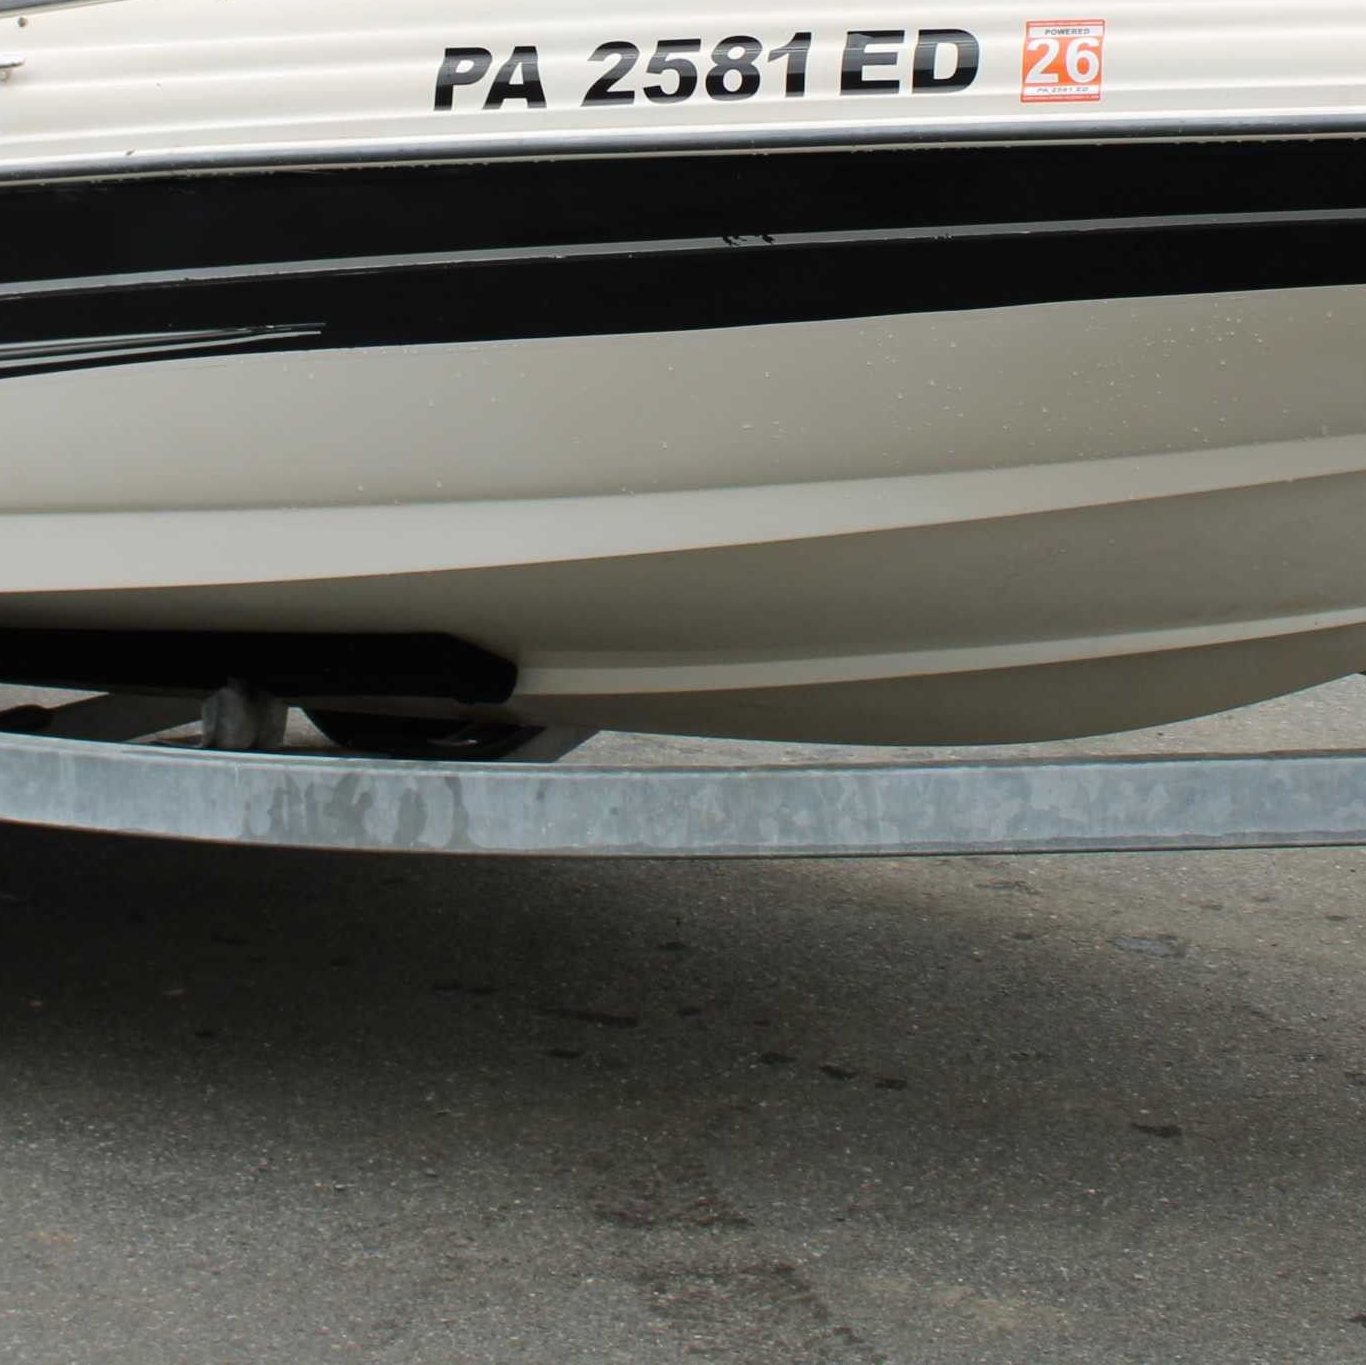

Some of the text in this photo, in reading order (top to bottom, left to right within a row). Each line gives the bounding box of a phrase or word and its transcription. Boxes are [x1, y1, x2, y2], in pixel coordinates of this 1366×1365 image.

[433, 28, 981, 111] PA 2581 ED
[1024, 37, 1100, 85] 26
